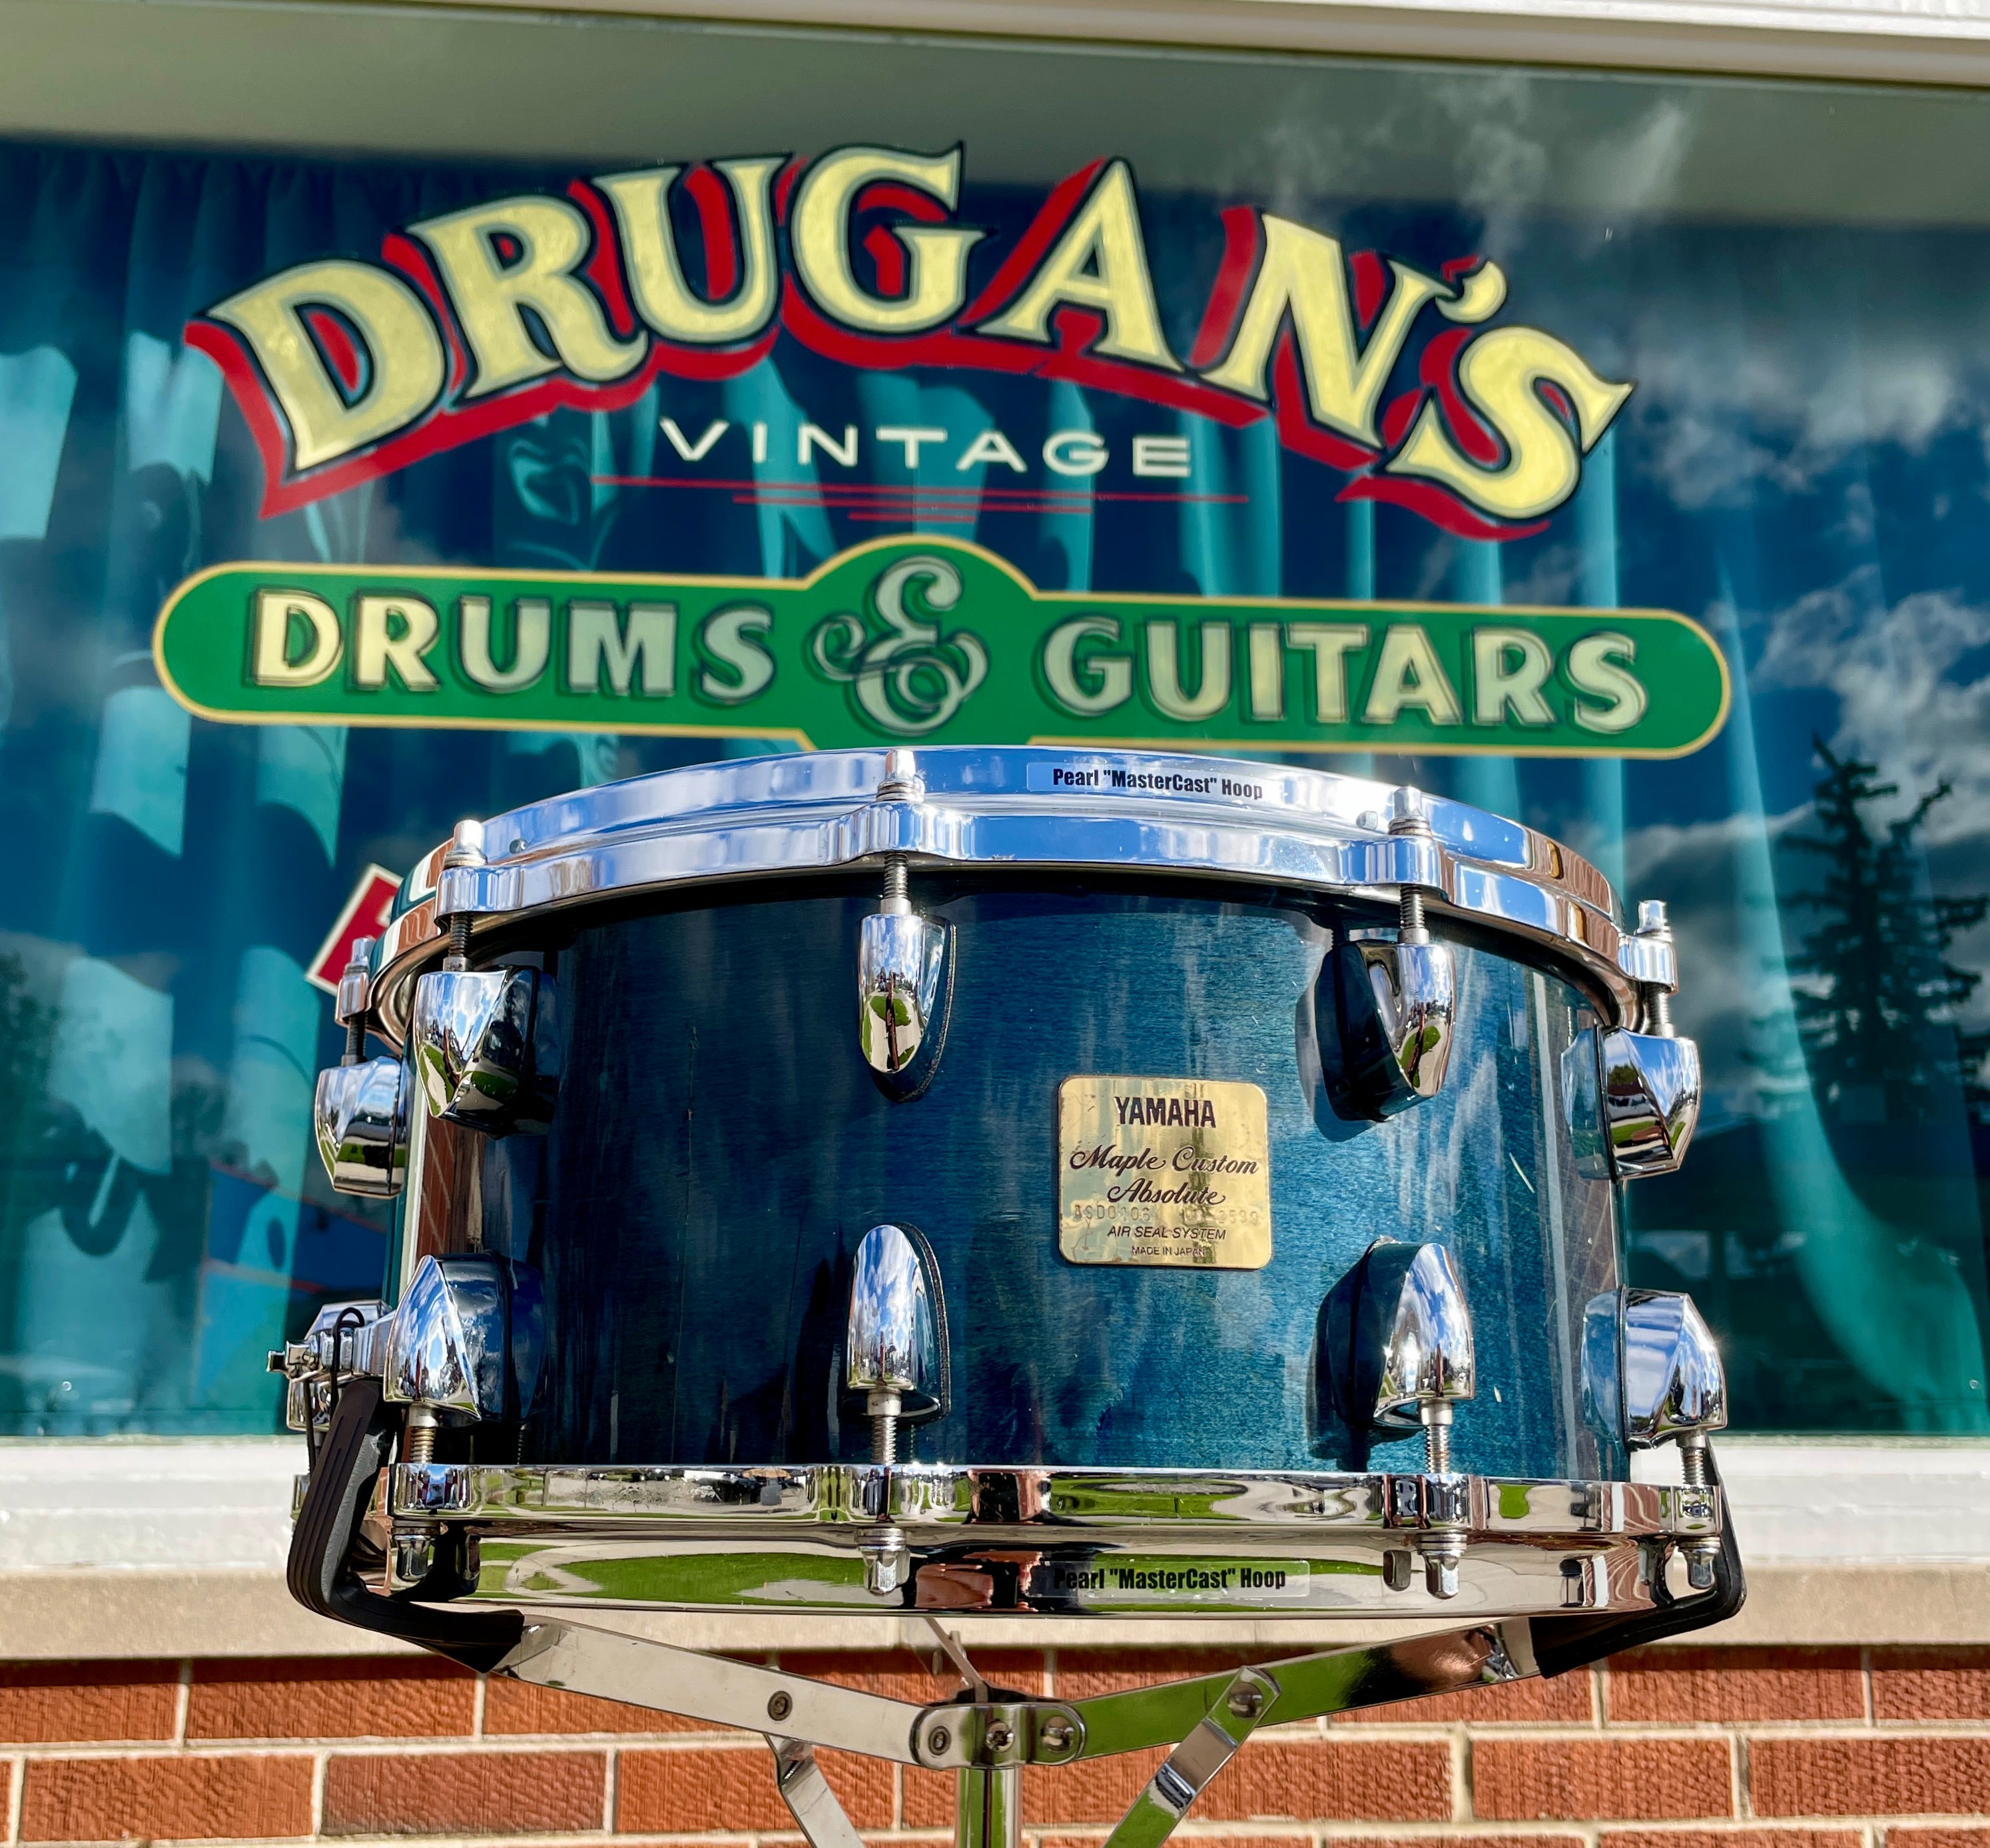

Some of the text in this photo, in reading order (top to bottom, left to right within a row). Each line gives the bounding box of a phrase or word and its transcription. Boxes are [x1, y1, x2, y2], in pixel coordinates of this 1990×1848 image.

[201, 141, 1635, 525] DRUGAN'S
[659, 416, 1193, 477] VINTAGE
[249, 553, 1649, 737] DRUMS & GUITARS
[1053, 768, 1263, 800] Pearl "MasterCast" Hoop
[1114, 1095, 1216, 1128] YAMAHA
[1069, 1144, 1259, 1177] Maple Custom
[1107, 1177, 1226, 1205] Absolute
[1107, 1225, 1226, 1240] AIR SEAL SYSTEM
[1132, 1246, 1160, 1255] MADE
[1174, 1247, 1205, 1256] JAPAN
[1053, 1568, 1286, 1590] Pearl "MasterCast" Hoop
